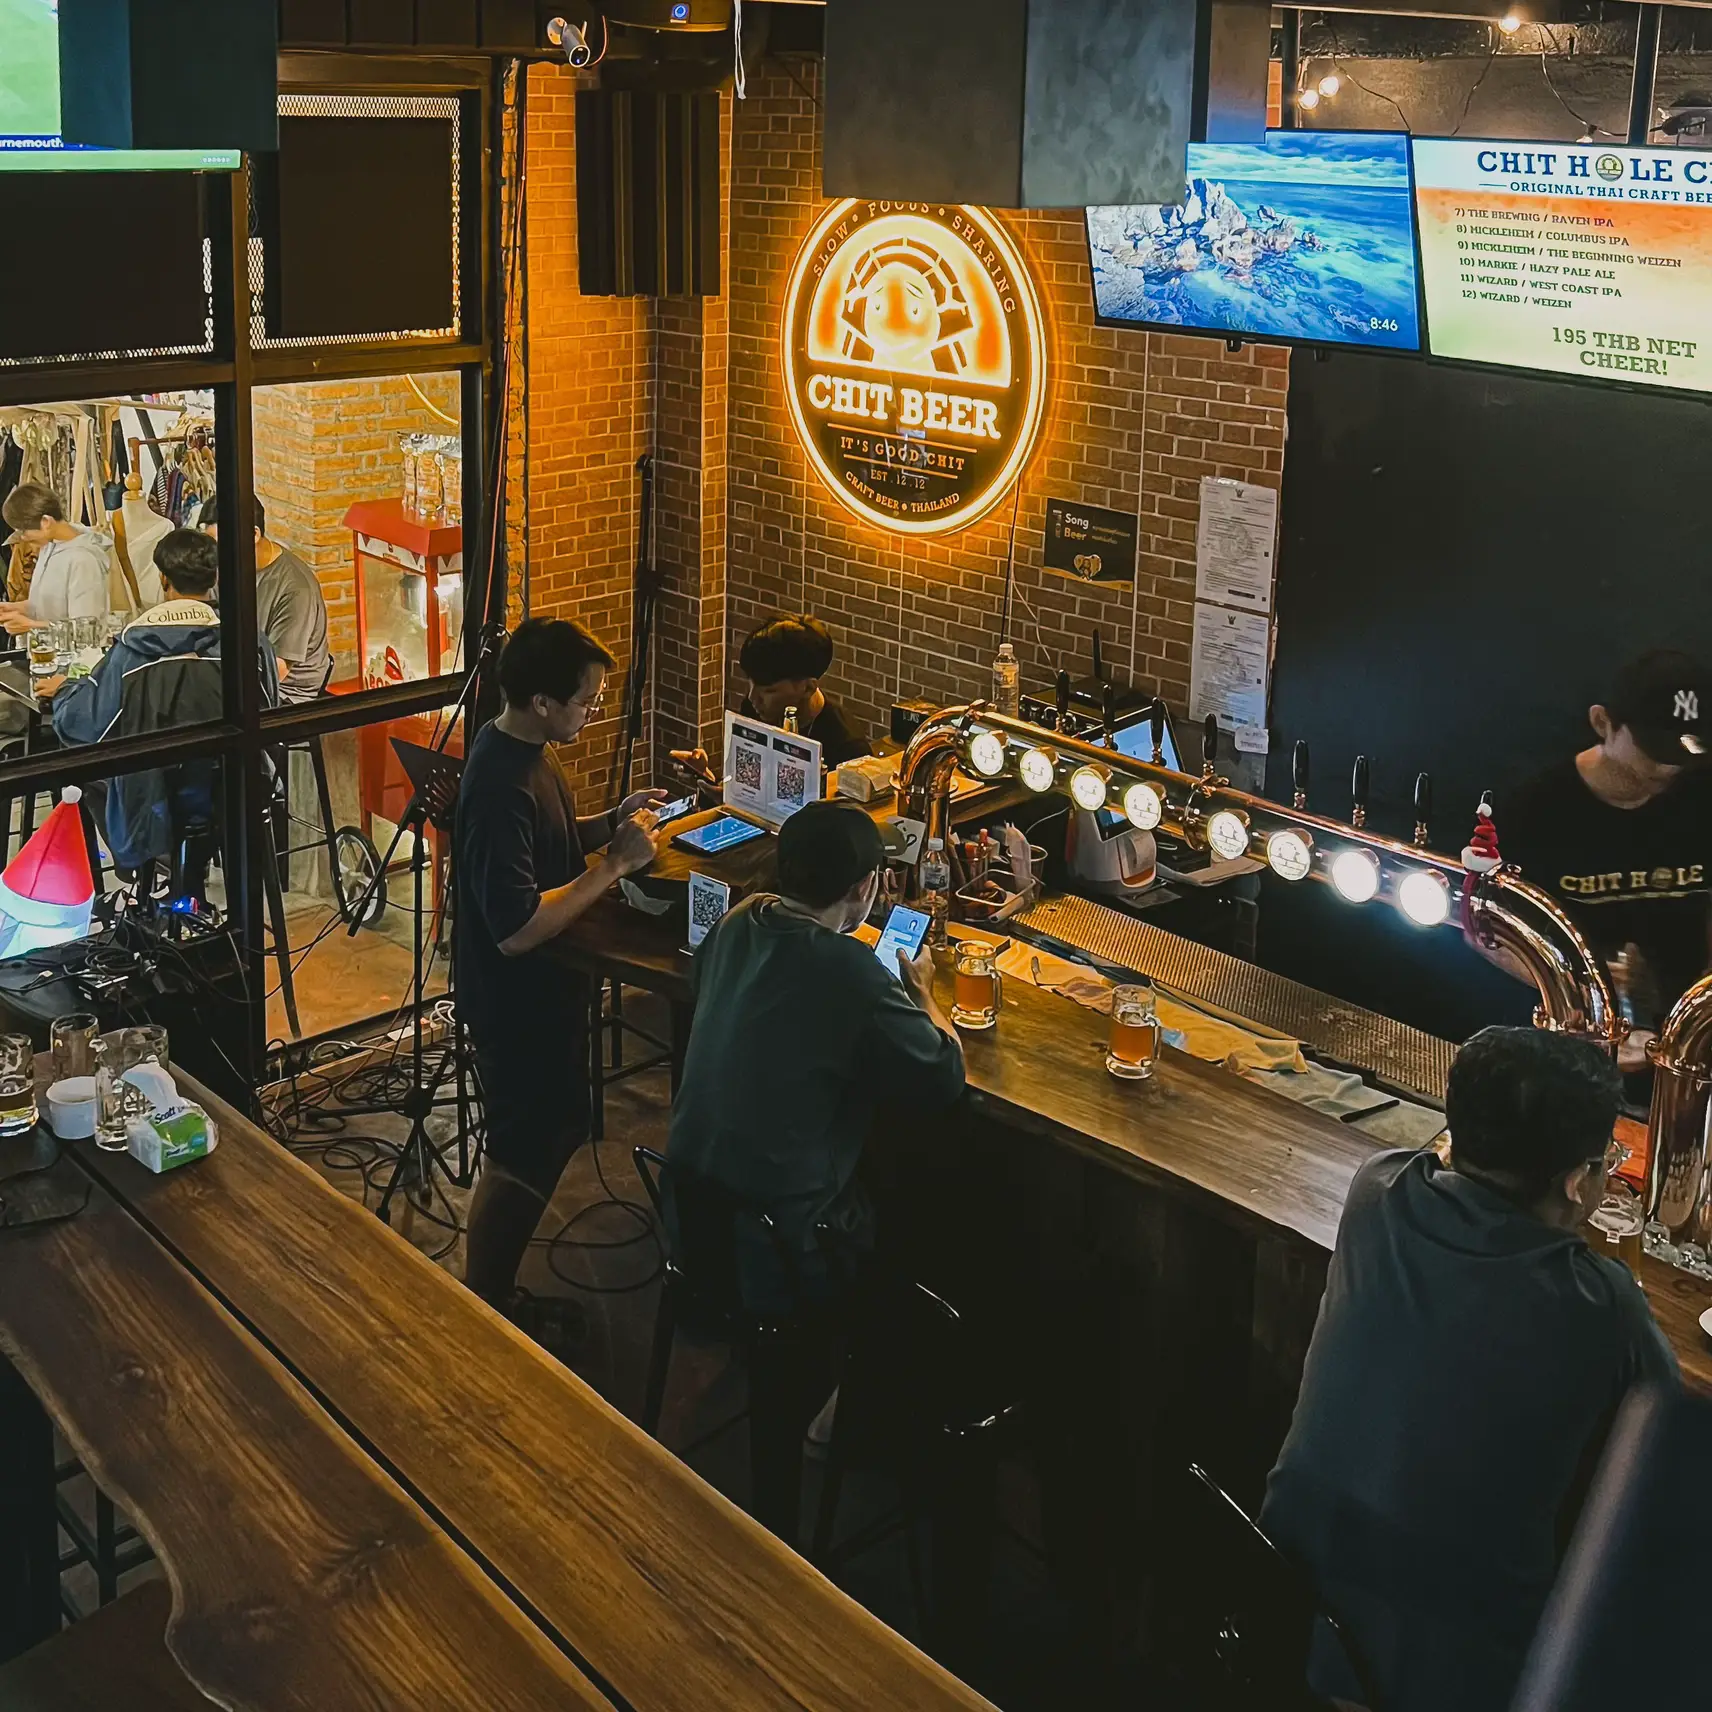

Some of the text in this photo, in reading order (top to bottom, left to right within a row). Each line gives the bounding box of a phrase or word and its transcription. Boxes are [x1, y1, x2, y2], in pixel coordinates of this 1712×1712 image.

[1477, 151, 1557, 176] CHIT
[1684, 160, 1712, 184] C
[1510, 181, 1584, 196] ORIGINAL
[1587, 185, 1624, 199] THAI
[1629, 188, 1681, 201] CRAFT
[1455, 207, 1465, 217] 7)
[1467, 209, 1489, 219] THE
[1491, 210, 1541, 222] BREWING
[1551, 215, 1591, 226] RAVEN
[1594, 217, 1615, 228] IPA
[1456, 224, 1467, 234] 8)
[1470, 225, 1535, 239] MICKLEHEIM
[1545, 231, 1606, 245] COLUMBUS
[1609, 236, 1630, 247] IPA
[813, 222, 850, 278] SLOW
[951, 215, 1017, 314] SHARING
[1457, 240, 1469, 250] 9)
[1471, 241, 1536, 256] MICKLEHEIM
[1547, 248, 1569, 259] THE
[1572, 250, 1635, 265] BEGINNING
[1637, 255, 1682, 268] WEIZEN
[1459, 257, 1475, 267] 10)
[1477, 258, 1519, 271] MARKIE
[1529, 263, 1560, 275] HAZY
[1563, 266, 1591, 278] PALE
[1594, 269, 1616, 280] ALE
[1460, 273, 1474, 283] 11)
[1476, 274, 1518, 287] WIZARD
[1529, 280, 1559, 291] WEST
[1561, 283, 1599, 296] COAST
[1602, 287, 1622, 298] IPA
[1461, 289, 1477, 300] 12)
[1479, 290, 1521, 304] WIZARD
[1531, 296, 1572, 309] WEIZEN
[1370, 317, 1399, 331] 8:46
[1552, 327, 1697, 358] 195 THB NET
[1579, 350, 1668, 376] CHEER!
[807, 373, 1002, 440] CHIT BEER
[840, 436, 966, 471] IT'S GOOD CHIT
[845, 471, 961, 513] CRAFT BEER THAILAND
[1064, 513, 1090, 530] Song
[1064, 527, 1088, 541] Beer
[147, 607, 212, 624] Columbia
[1673, 689, 1699, 721] NY
[1559, 872, 1623, 894] CHIT
[154, 1105, 176, 1125] Scott
